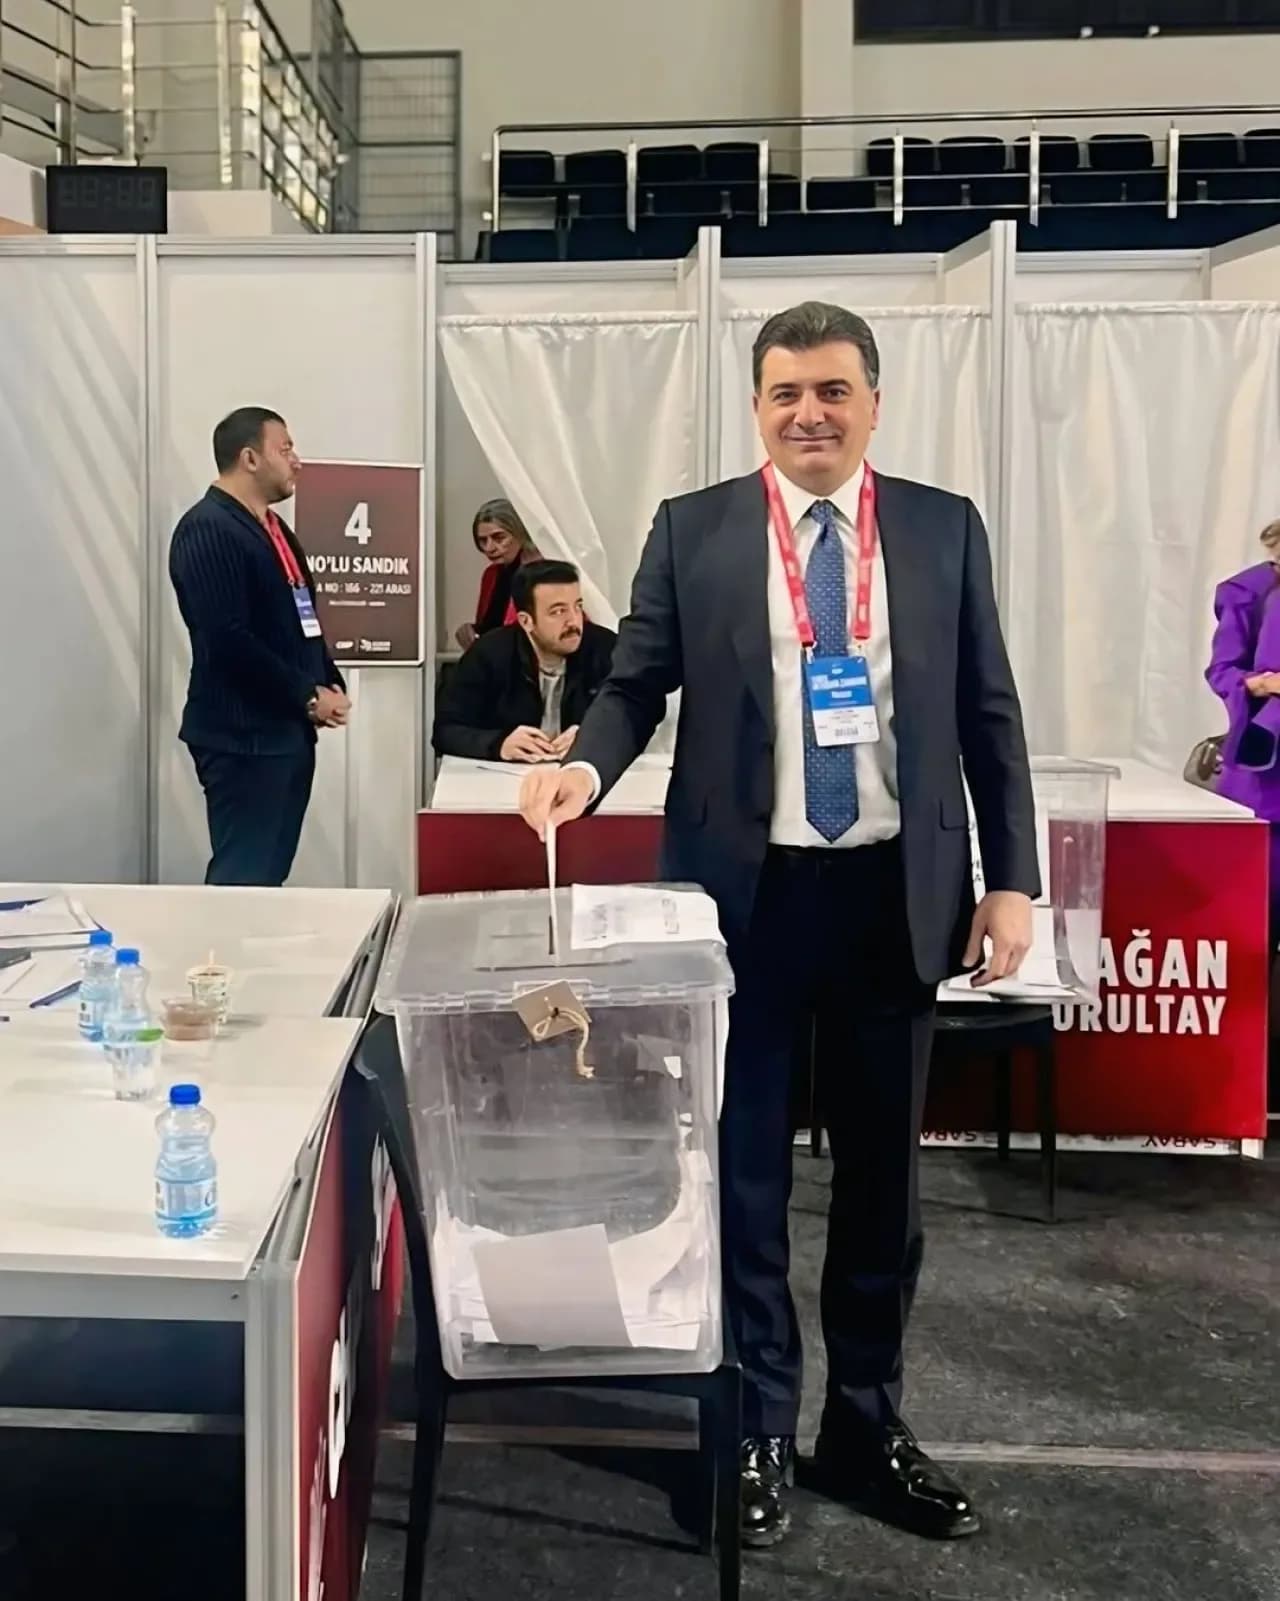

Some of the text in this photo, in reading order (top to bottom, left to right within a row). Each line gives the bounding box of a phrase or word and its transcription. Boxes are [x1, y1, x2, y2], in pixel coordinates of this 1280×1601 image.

[344, 502, 372, 545] 4
[352, 556, 409, 575] SANDIK
[1099, 929, 1228, 989] AĞAN
[1051, 993, 1227, 1036] URULTAY
[920, 1129, 977, 1142] SARA
